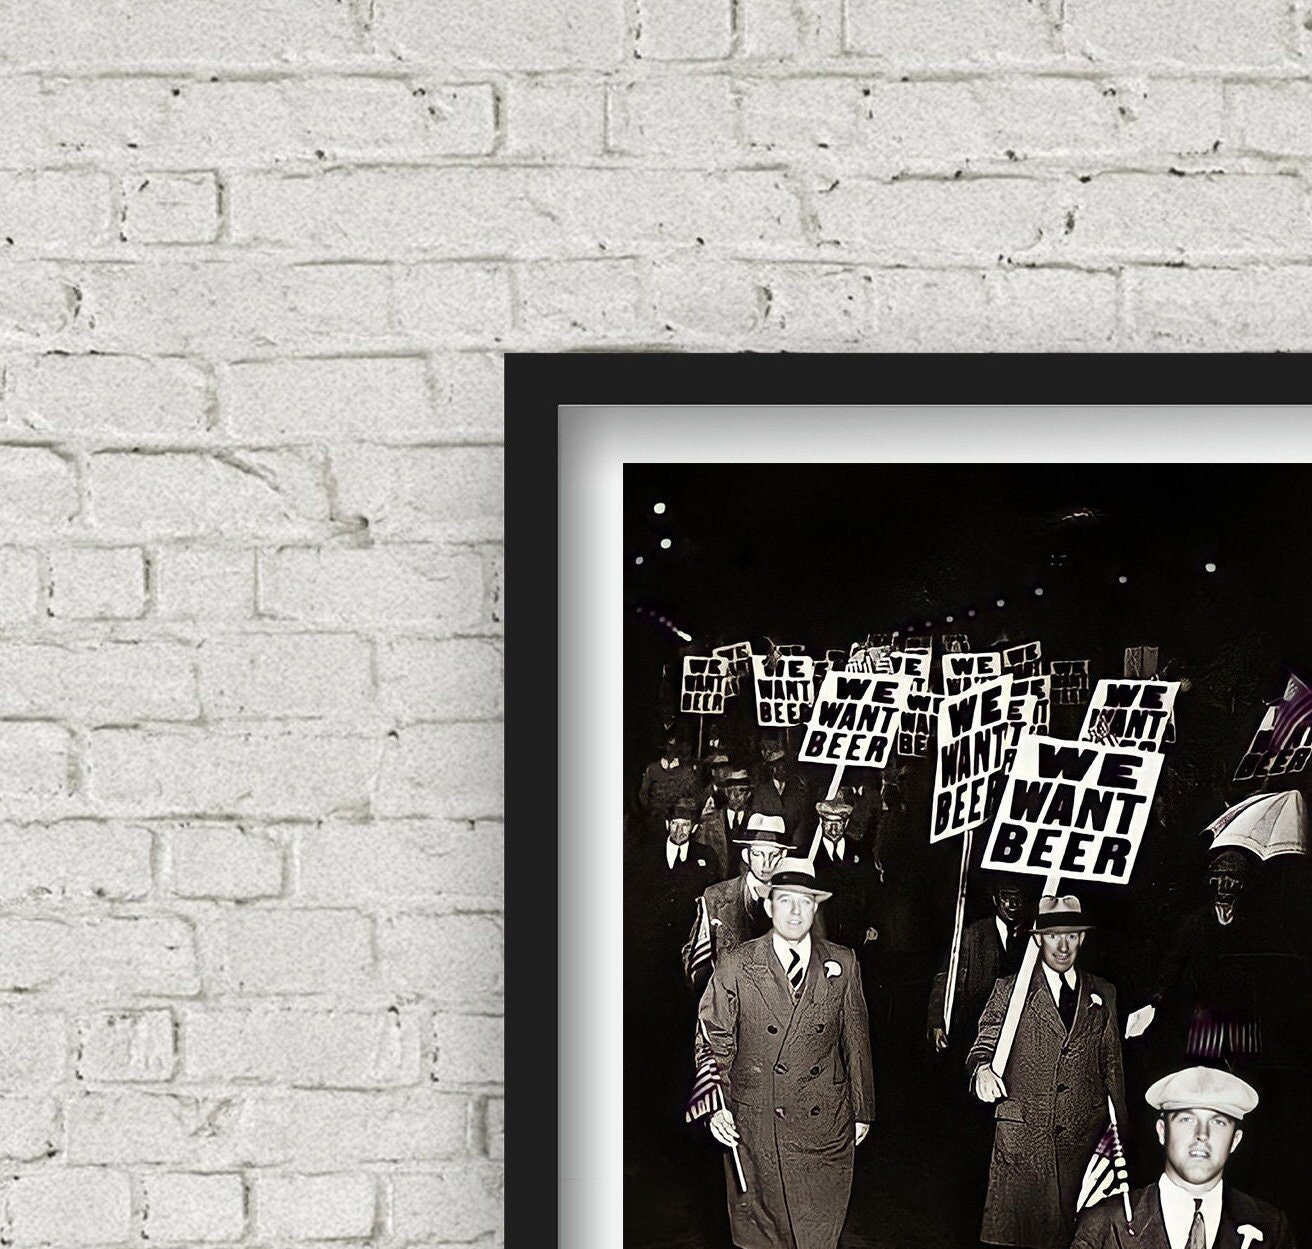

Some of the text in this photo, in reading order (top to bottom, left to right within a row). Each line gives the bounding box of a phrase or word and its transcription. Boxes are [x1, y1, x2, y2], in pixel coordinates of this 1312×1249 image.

[950, 656, 993, 676] WE
[757, 679, 810, 701] WANT
[836, 677, 899, 704] WE
[1103, 684, 1168, 709] WE
[818, 701, 900, 733] WANT
[948, 685, 1002, 738] WE
[805, 730, 888, 763] BEER
[899, 733, 929, 756] BE
[941, 722, 1008, 788] WANT
[1038, 742, 1144, 790] WE
[1009, 779, 1147, 835] WANT
[989, 822, 1132, 877] BEER
